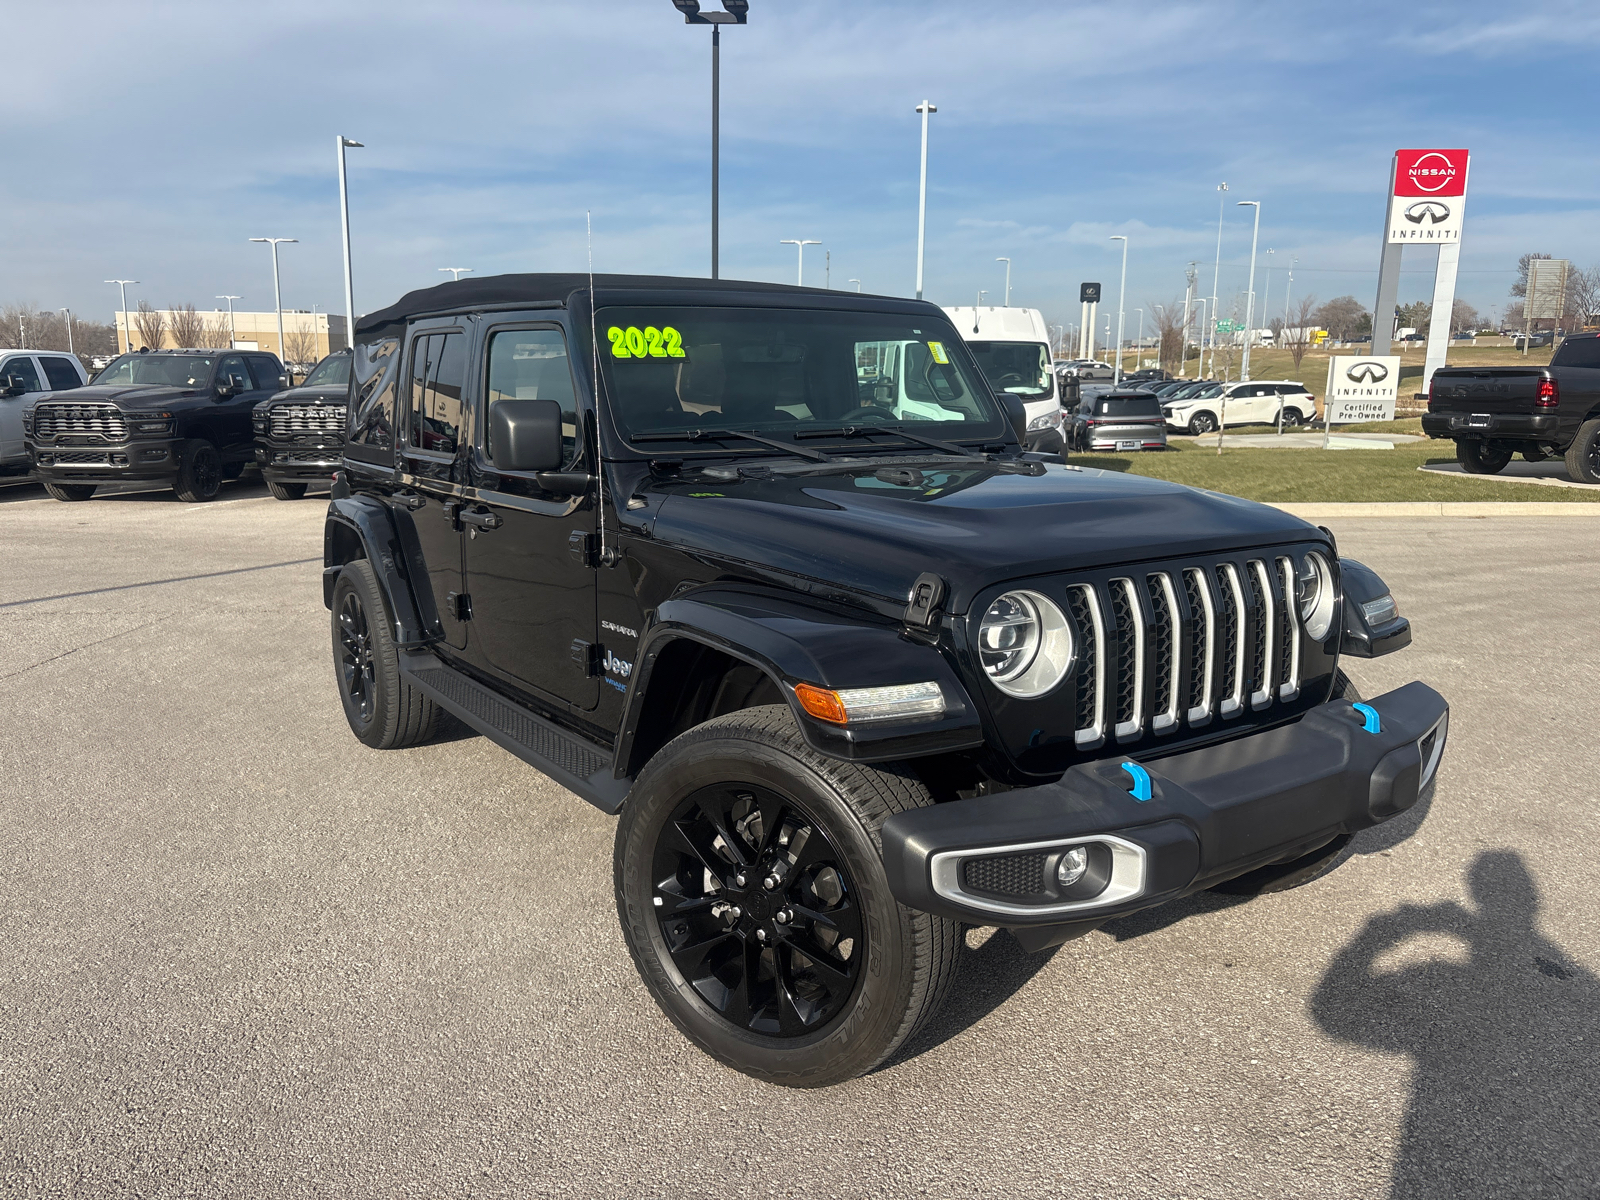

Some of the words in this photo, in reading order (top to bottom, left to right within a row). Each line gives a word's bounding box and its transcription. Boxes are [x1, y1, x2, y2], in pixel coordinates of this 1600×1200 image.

[1408, 168, 1456, 176] NISSAN
[1392, 230, 1458, 239] INFINITI
[607, 326, 686, 358] 2022
[1337, 388, 1393, 396] INFINITI
[1454, 384, 1512, 395] RAM
[1344, 403, 1383, 411] Certified
[54, 410, 99, 419] RAM
[601, 620, 639, 638] SAHARA
